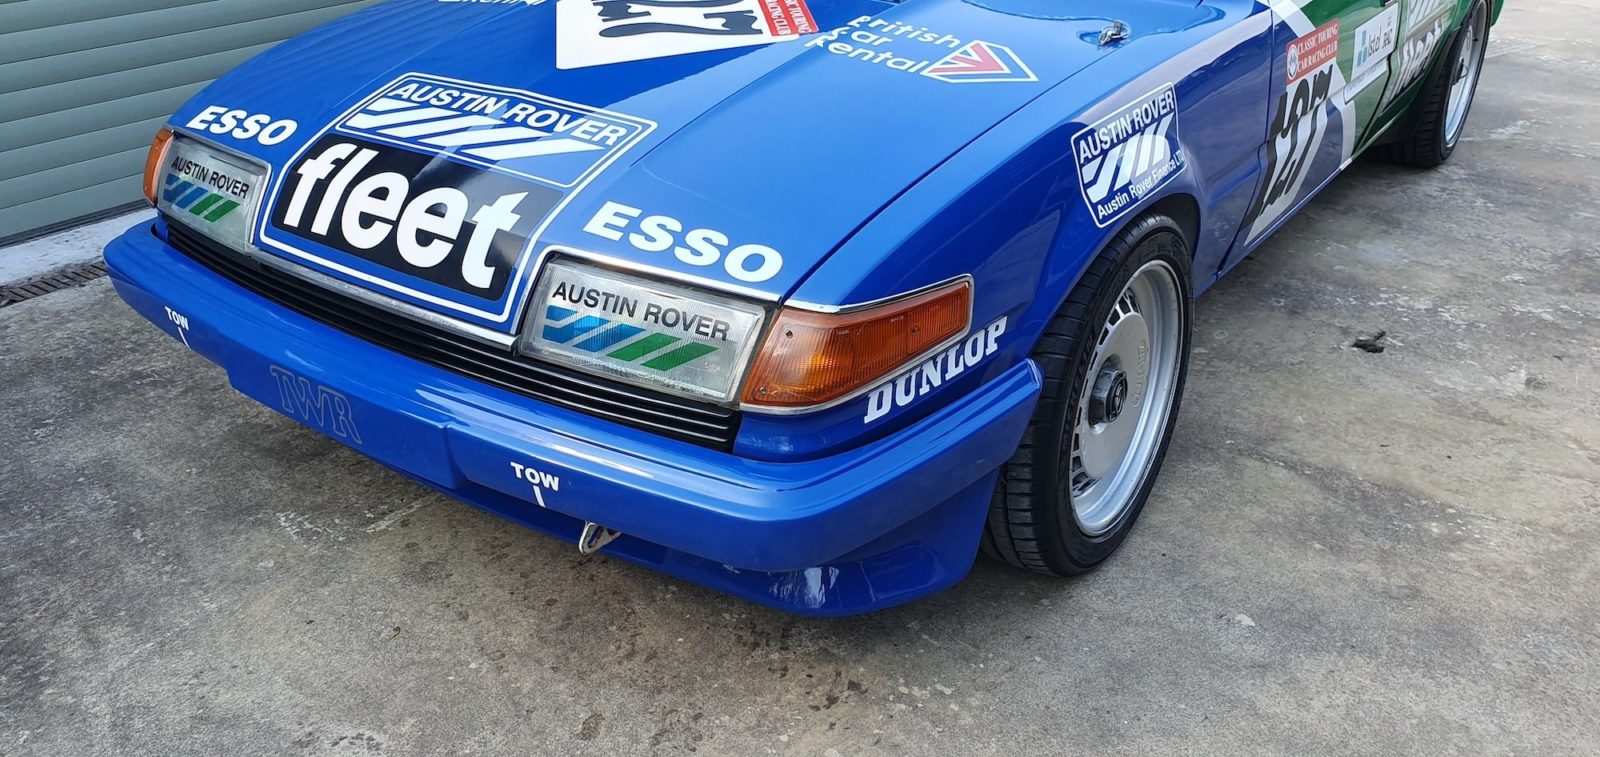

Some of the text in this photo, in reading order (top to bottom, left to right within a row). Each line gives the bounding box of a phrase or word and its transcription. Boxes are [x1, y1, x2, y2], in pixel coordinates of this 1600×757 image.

[186, 105, 298, 146] ESSO
[388, 82, 629, 146] AUSTIN ROVER
[1079, 90, 1175, 164] AUSTIN ROVER
[171, 155, 250, 200] AUSTIN ROVER
[1096, 191, 1131, 220] Austin
[1128, 175, 1153, 201] Rover
[1151, 159, 1177, 184] Finance
[283, 142, 530, 289] fleet
[582, 200, 784, 283] ESSO
[164, 305, 190, 333] TOW
[551, 281, 731, 341] AUSTIN ROVER
[863, 315, 1008, 424] DUNLOP
[268, 364, 363, 445] TWR
[510, 461, 560, 492] TOW
